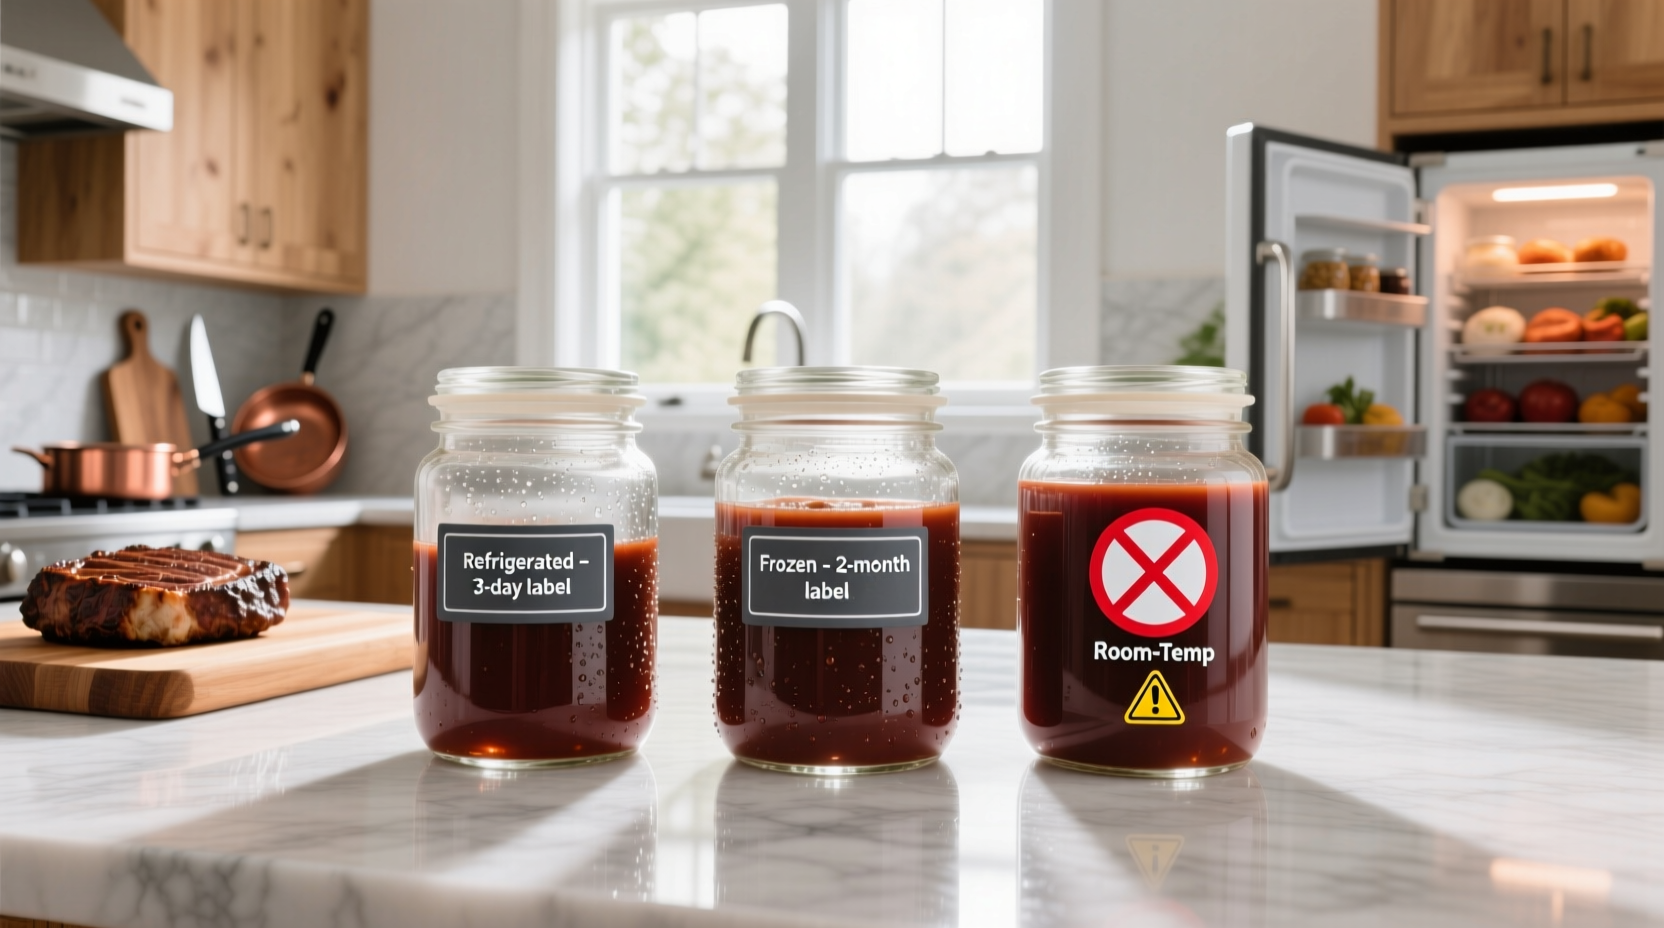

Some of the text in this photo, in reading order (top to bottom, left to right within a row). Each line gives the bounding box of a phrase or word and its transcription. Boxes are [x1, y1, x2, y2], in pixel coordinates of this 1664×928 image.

[463, 551, 574, 575] Refrigerated
[760, 554, 817, 574] Frozen
[835, 554, 911, 574] 2-month
[472, 577, 571, 601] 3-day label
[804, 581, 850, 600] label
[1094, 641, 1215, 667] Room-Temp
